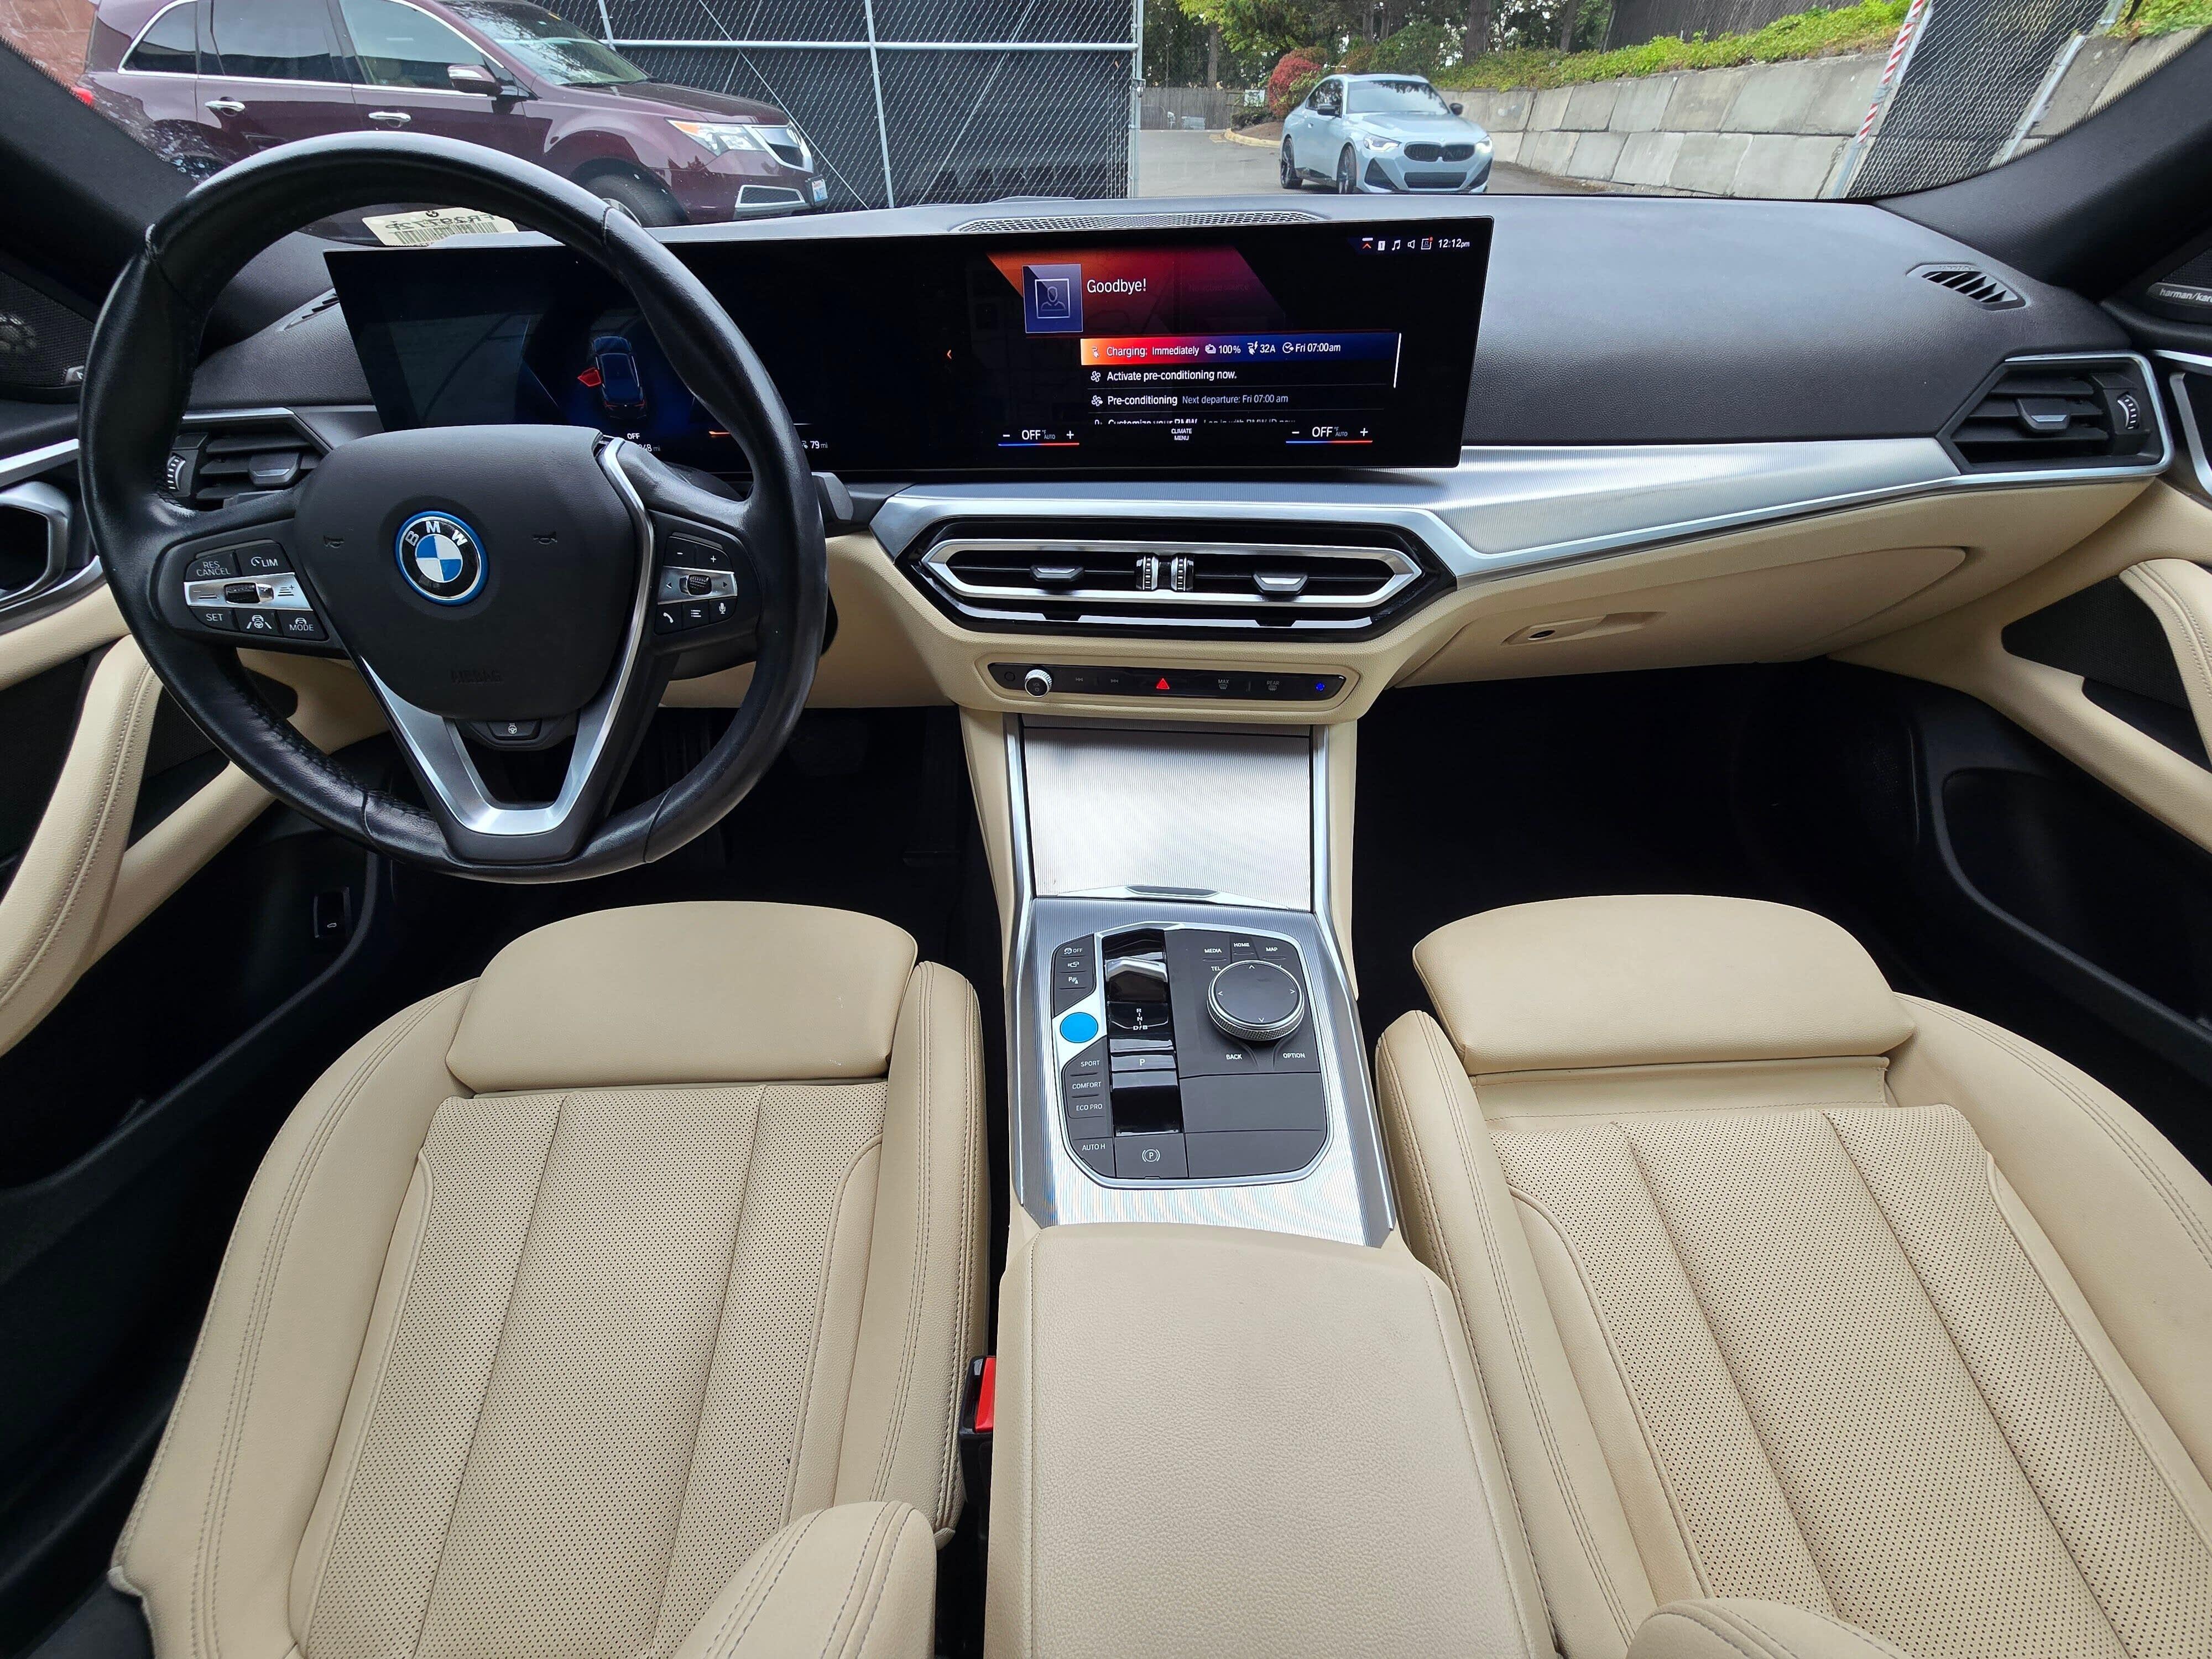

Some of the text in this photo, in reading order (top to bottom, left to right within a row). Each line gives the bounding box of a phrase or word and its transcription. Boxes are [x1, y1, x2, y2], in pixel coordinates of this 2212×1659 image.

[1087, 278, 1146, 295] Goodbye!
[1107, 343, 1341, 357] Charging: Immediately 100% 32A Fri 07:00am
[1107, 370, 1237, 382] Activate pre-conditioning now.
[1108, 395, 1178, 406] Pre-conditioning
[1201, 395, 1241, 405] departure:
[1242, 395, 1252, 403] Fri
[1254, 394, 1275, 403] 07:00
[1021, 430, 1041, 440] OFF
[1312, 426, 1333, 437] OFF
[810, 440, 820, 449] 79
[405, 520, 468, 547] BMW
[202, 561, 220, 569] RES
[261, 559, 278, 567] LIM
[196, 567, 231, 577] CANCEL
[206, 613, 223, 622] SET
[289, 623, 314, 632] MODE
[1072, 1081, 1102, 1089] COMFORT
